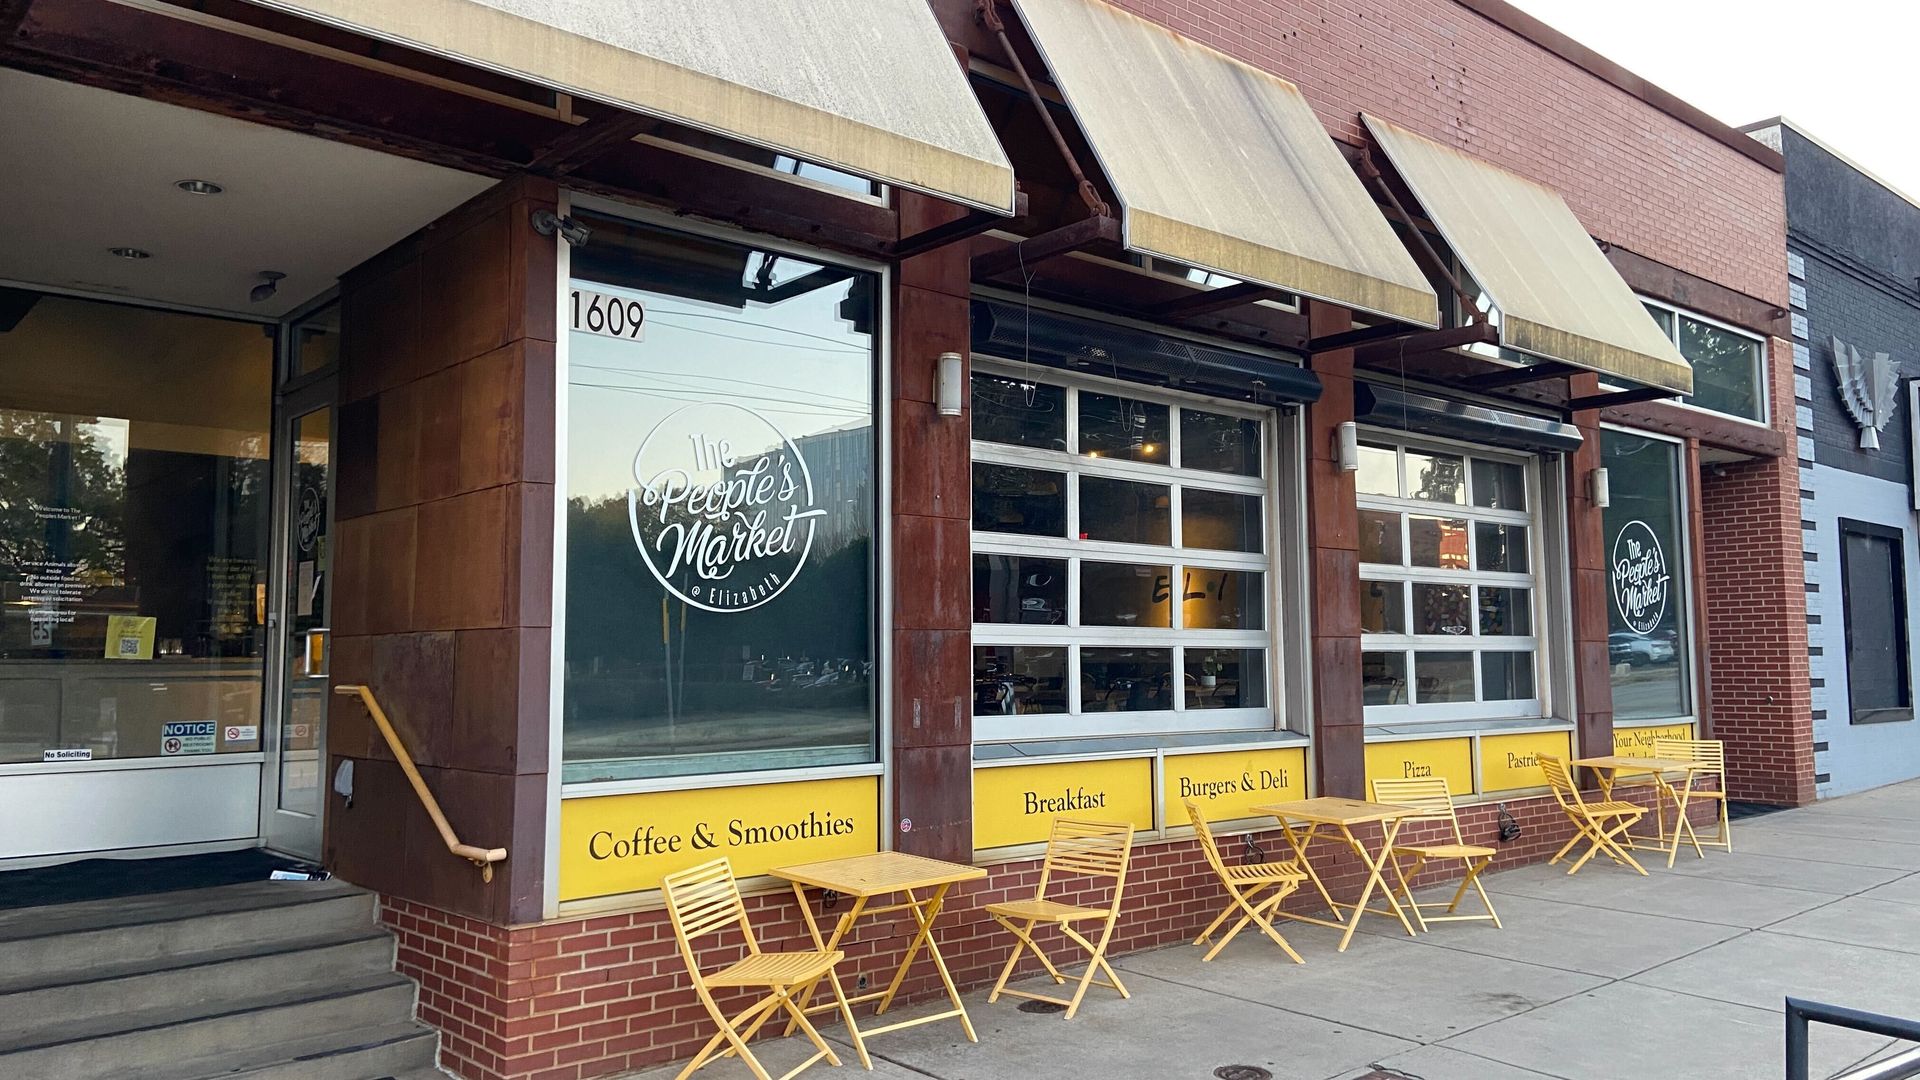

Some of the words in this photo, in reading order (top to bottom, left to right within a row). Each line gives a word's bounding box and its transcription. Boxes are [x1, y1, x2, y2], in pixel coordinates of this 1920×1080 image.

[571, 291, 644, 338] 1609
[688, 433, 736, 471] The
[642, 454, 799, 524] People's
[656, 504, 827, 579] Market
[1627, 539, 1641, 560] The
[1616, 547, 1660, 589] People's
[709, 572, 781, 606] Elizabeth
[1621, 573, 1670, 617] Market
[164, 723, 215, 735] NOTICE
[1613, 733, 1633, 748] Your
[57, 751, 91, 759] Soliciting
[1403, 761, 1431, 779] Pizza
[1507, 752, 1540, 769] Pastrie
[1023, 786, 1106, 815] Breakfast
[1179, 776, 1236, 800] Burgers
[1241, 772, 1255, 792] &
[1260, 769, 1289, 790] Deli
[589, 826, 682, 860] Coffee
[691, 822, 720, 849] &
[728, 811, 854, 847] Smoothies
